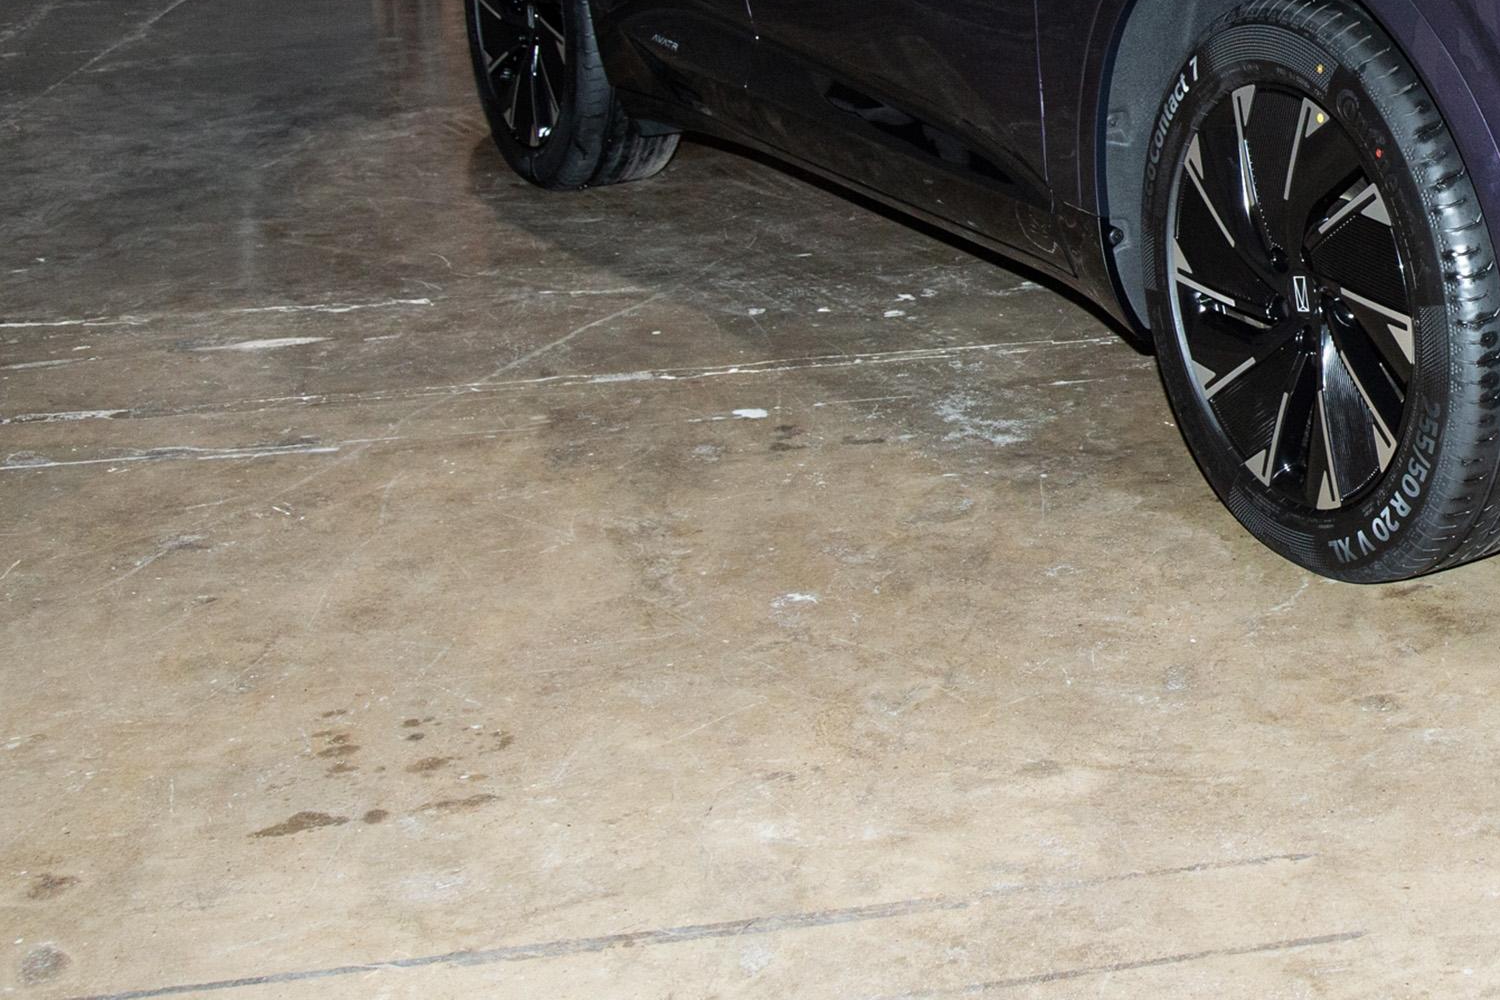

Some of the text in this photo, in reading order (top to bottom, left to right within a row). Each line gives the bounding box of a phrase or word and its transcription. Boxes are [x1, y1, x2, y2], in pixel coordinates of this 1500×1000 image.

[1188, 55, 1199, 82] 7
[1328, 536, 1358, 564] XL
[1357, 530, 1376, 556] V
